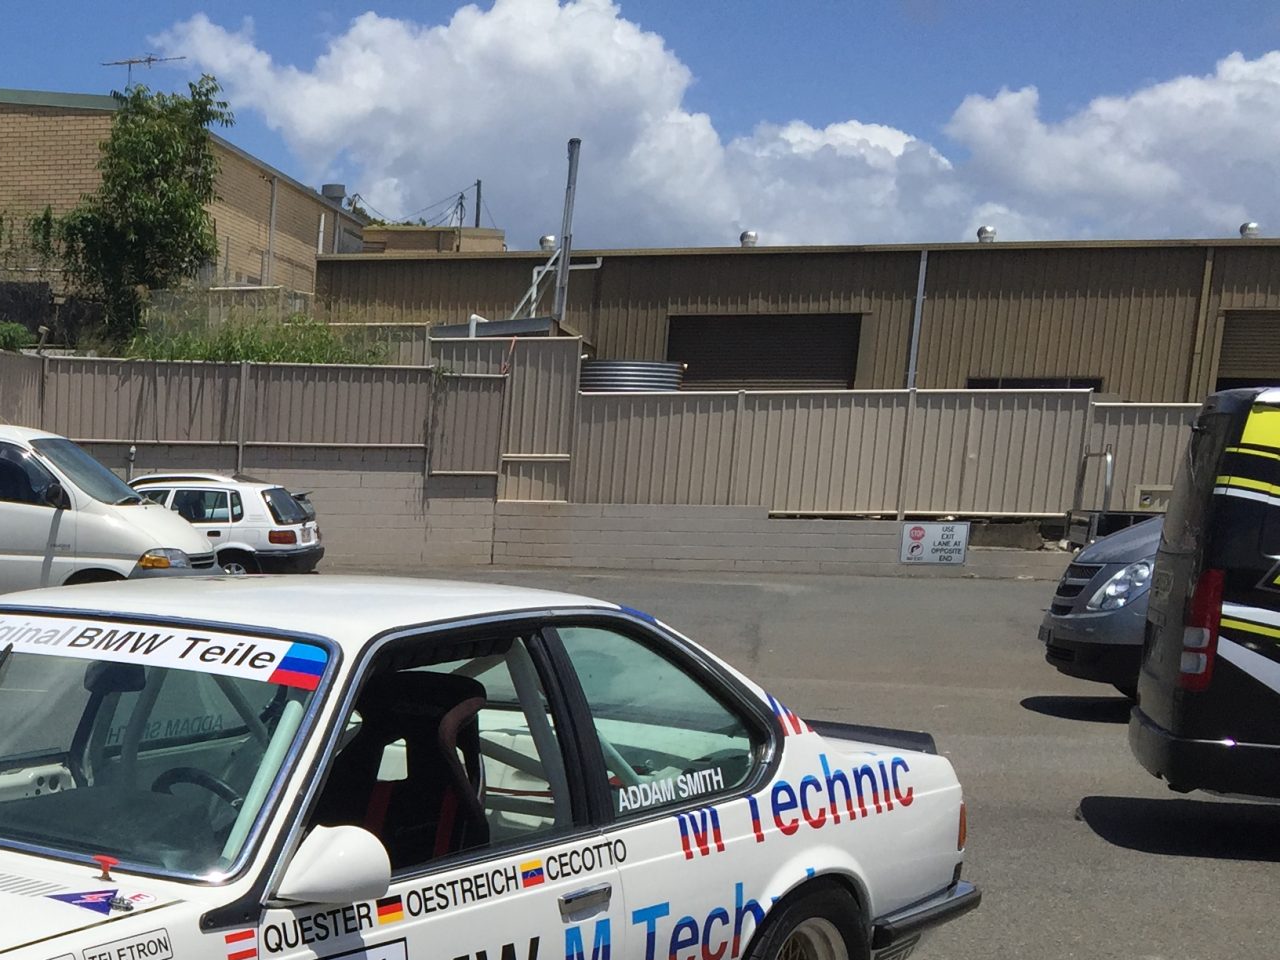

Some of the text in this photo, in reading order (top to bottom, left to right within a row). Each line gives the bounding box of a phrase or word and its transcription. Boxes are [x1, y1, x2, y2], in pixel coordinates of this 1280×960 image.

[67, 626, 175, 657] BMW
[177, 636, 277, 671] Teile
[618, 767, 724, 813] ADDAM SMITH
[745, 753, 914, 843] Technic
[263, 838, 628, 954] QUESTER OESTREICH CECOTTO
